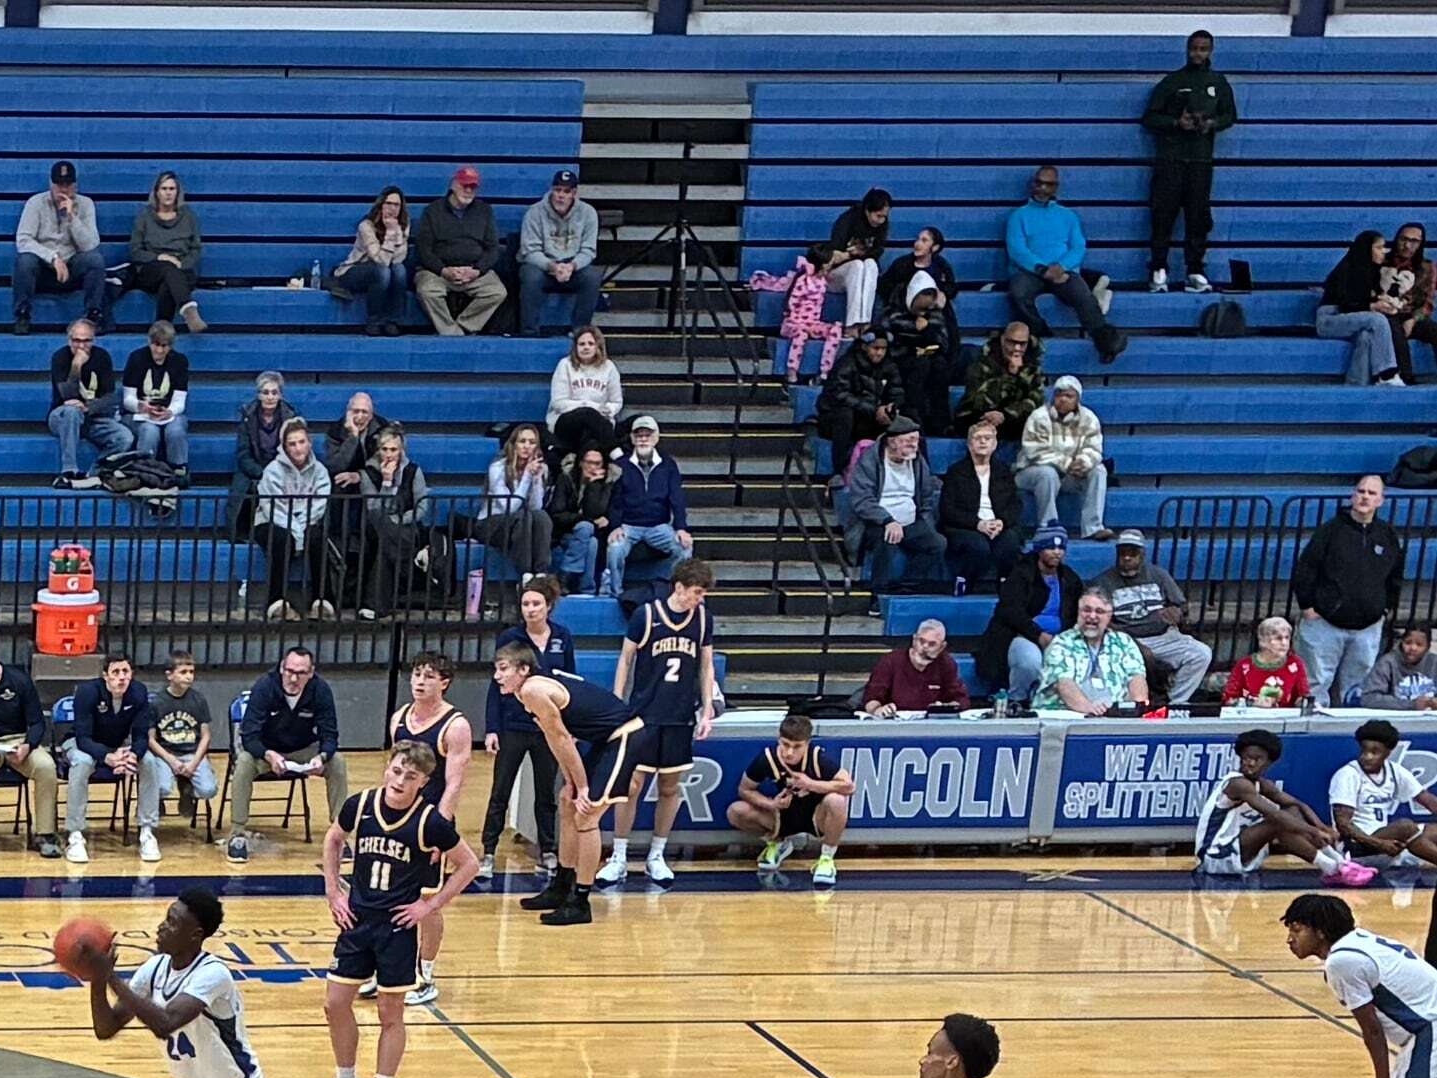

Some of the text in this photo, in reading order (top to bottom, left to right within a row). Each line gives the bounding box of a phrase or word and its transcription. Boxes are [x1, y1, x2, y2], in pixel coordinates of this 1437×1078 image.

[561, 171, 572, 181] C
[651, 636, 697, 658] CHELSEA
[664, 657, 682, 682] 2
[1105, 743, 1240, 781] WE ARE TH
[840, 747, 1034, 818] INCOLN
[1063, 782, 1186, 819] SPLITTER
[358, 836, 411, 863] CHELSEA
[370, 860, 391, 891] 11
